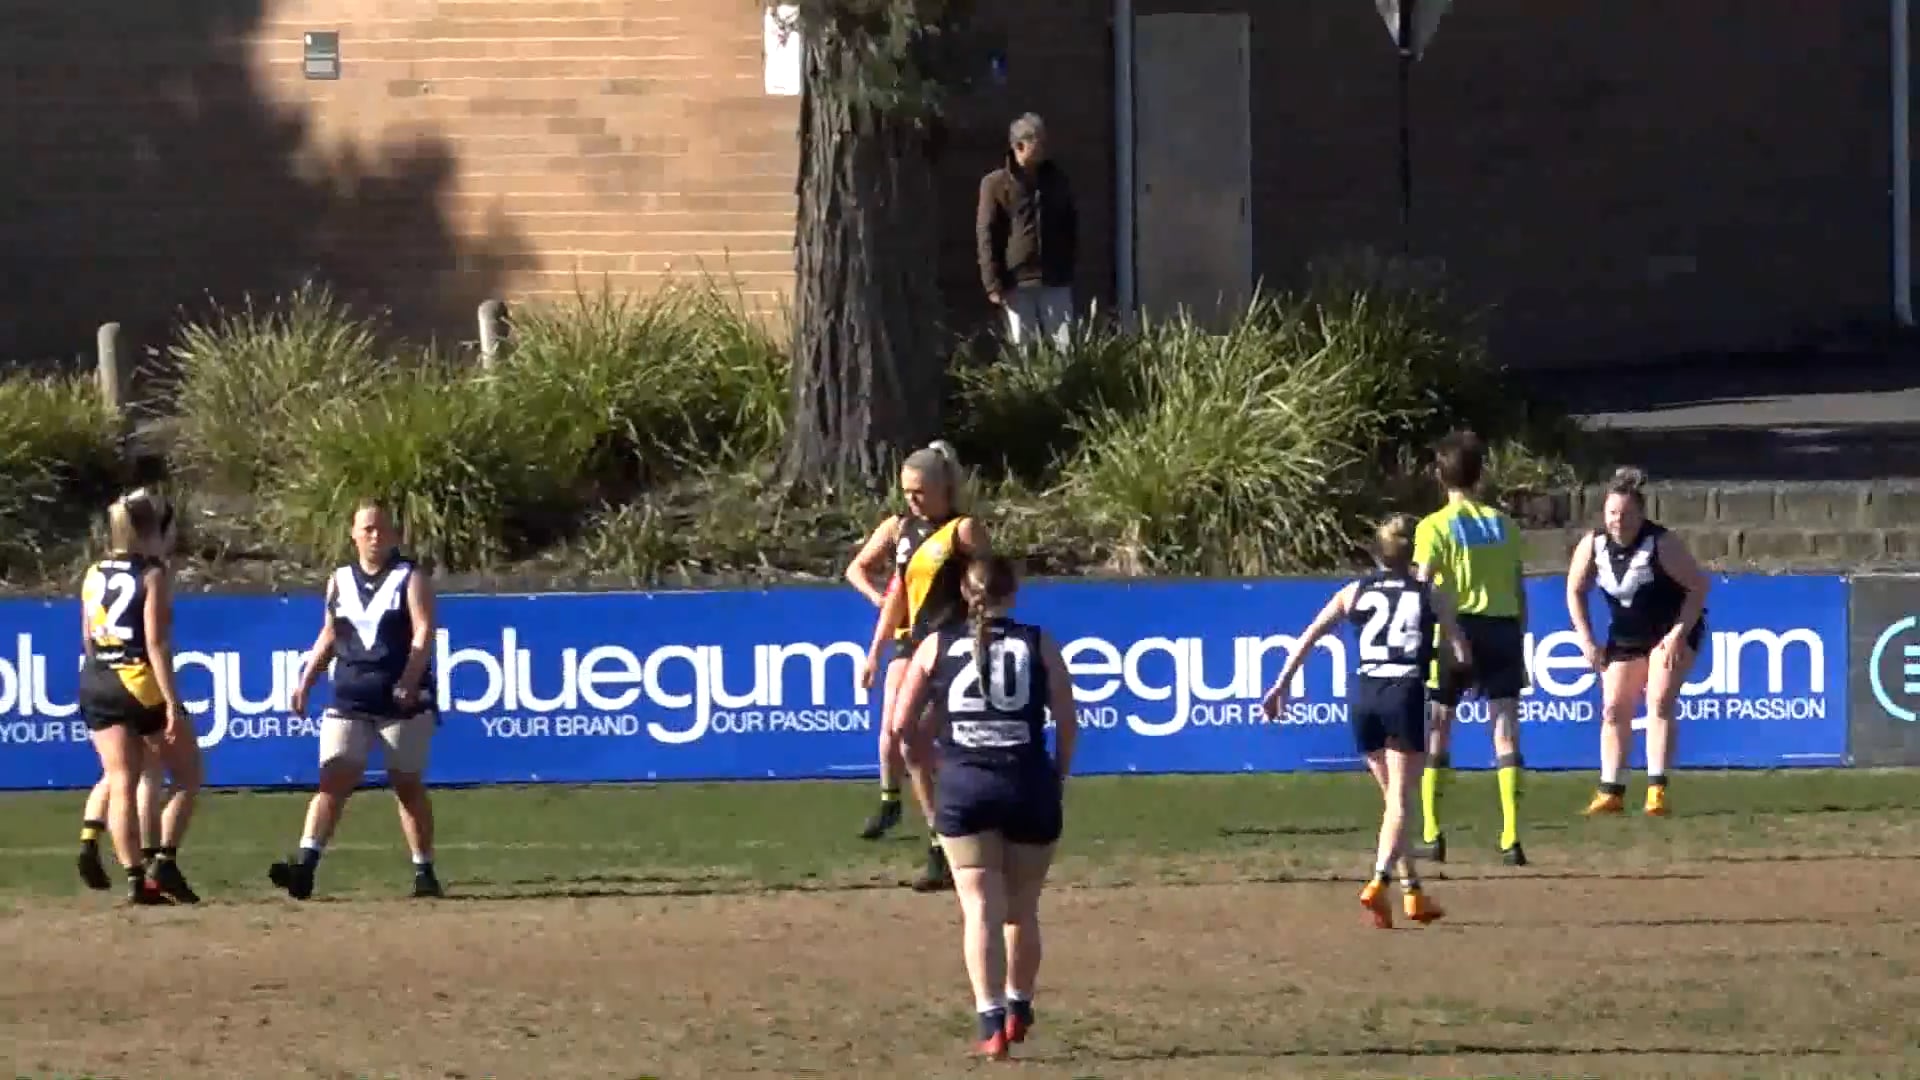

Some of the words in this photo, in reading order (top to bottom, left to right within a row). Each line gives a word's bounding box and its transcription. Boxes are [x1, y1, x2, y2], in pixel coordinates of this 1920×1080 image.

[1355, 590, 1422, 660] 24
[436, 627, 868, 744] bluegum
[947, 637, 1030, 711] 20
[1061, 636, 1346, 736] egum
[711, 711, 764, 733] OUR
[769, 709, 870, 732] PASSION
[1191, 703, 1242, 726] OUR
[1248, 702, 1348, 724] PSSION
[1726, 698, 1825, 720] PASSION
[0, 721, 66, 743] YOUR
[229, 717, 281, 738] OUR
[481, 716, 550, 738] YOUR
[555, 714, 639, 737] BRAND
